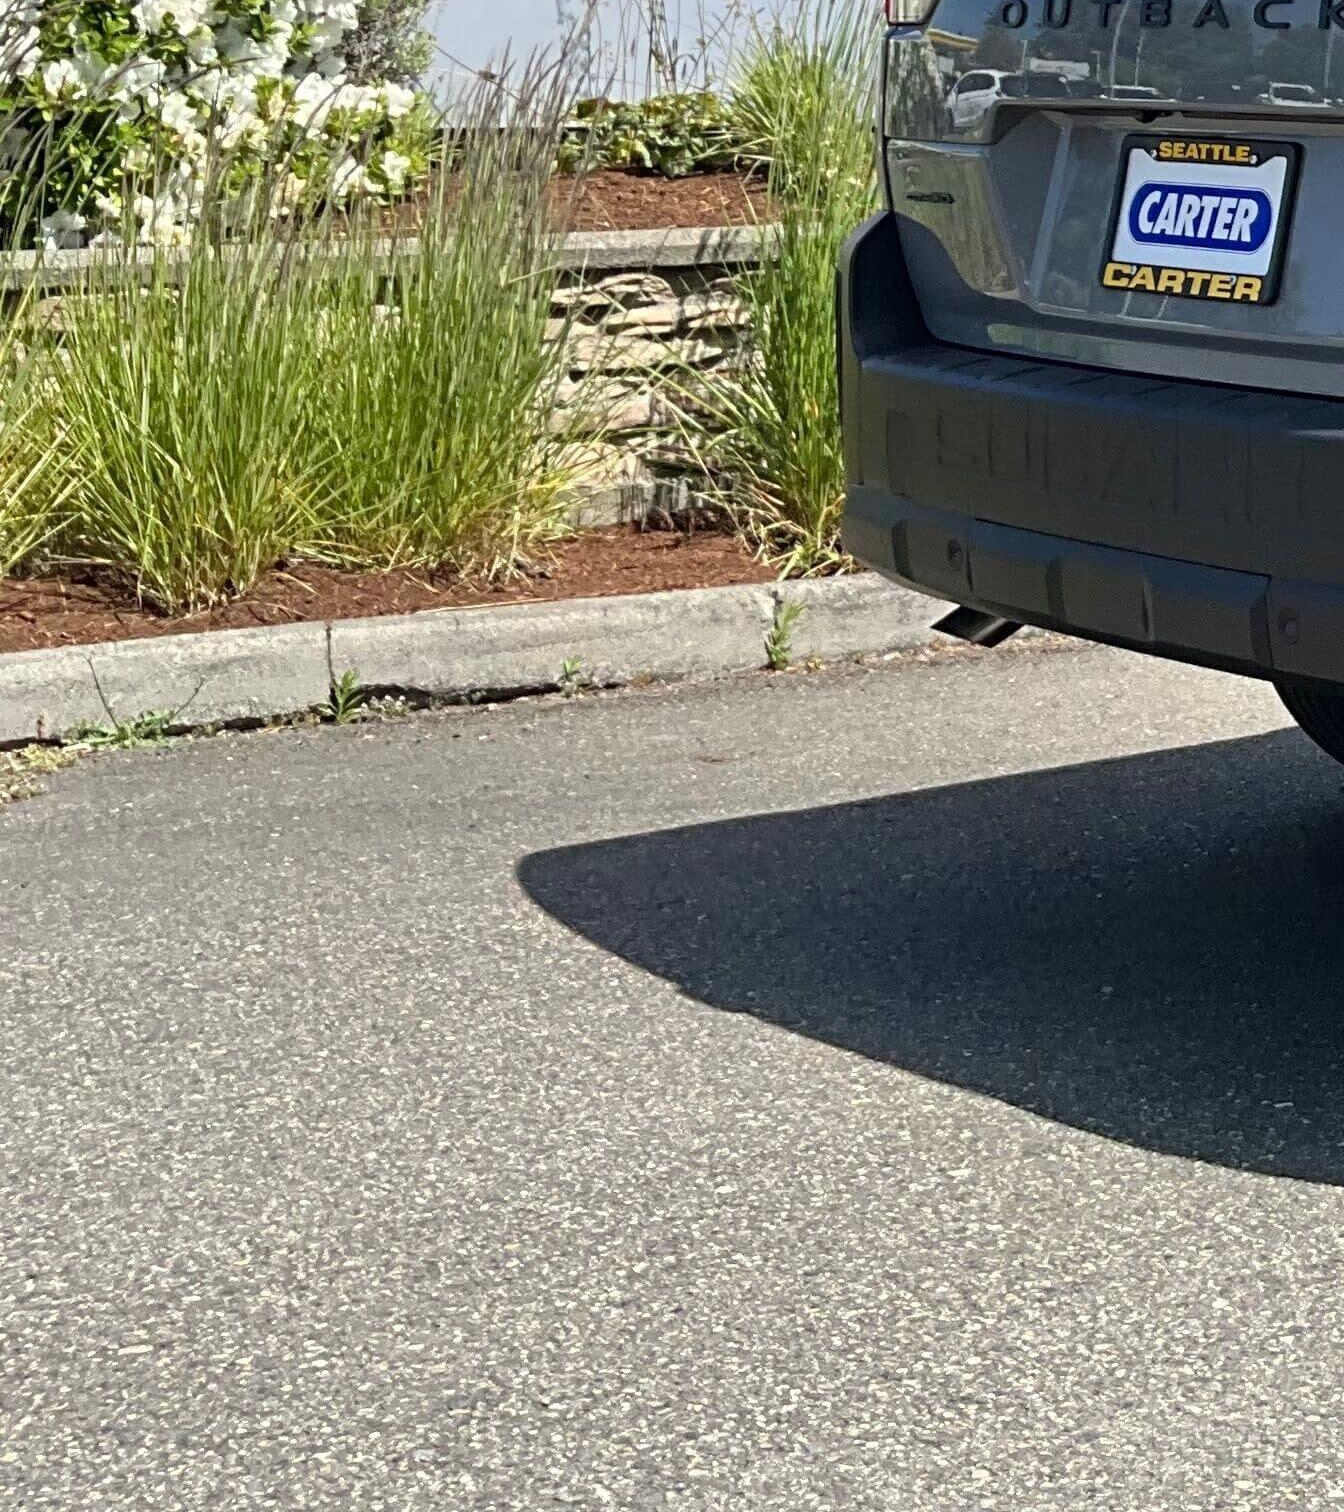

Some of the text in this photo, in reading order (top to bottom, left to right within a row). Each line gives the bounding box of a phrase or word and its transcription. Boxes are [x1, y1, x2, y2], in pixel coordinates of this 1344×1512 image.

[1158, 141, 1251, 164] SEATTLE
[1137, 189, 1260, 243] CARTER
[1102, 262, 1263, 302] CARTER
